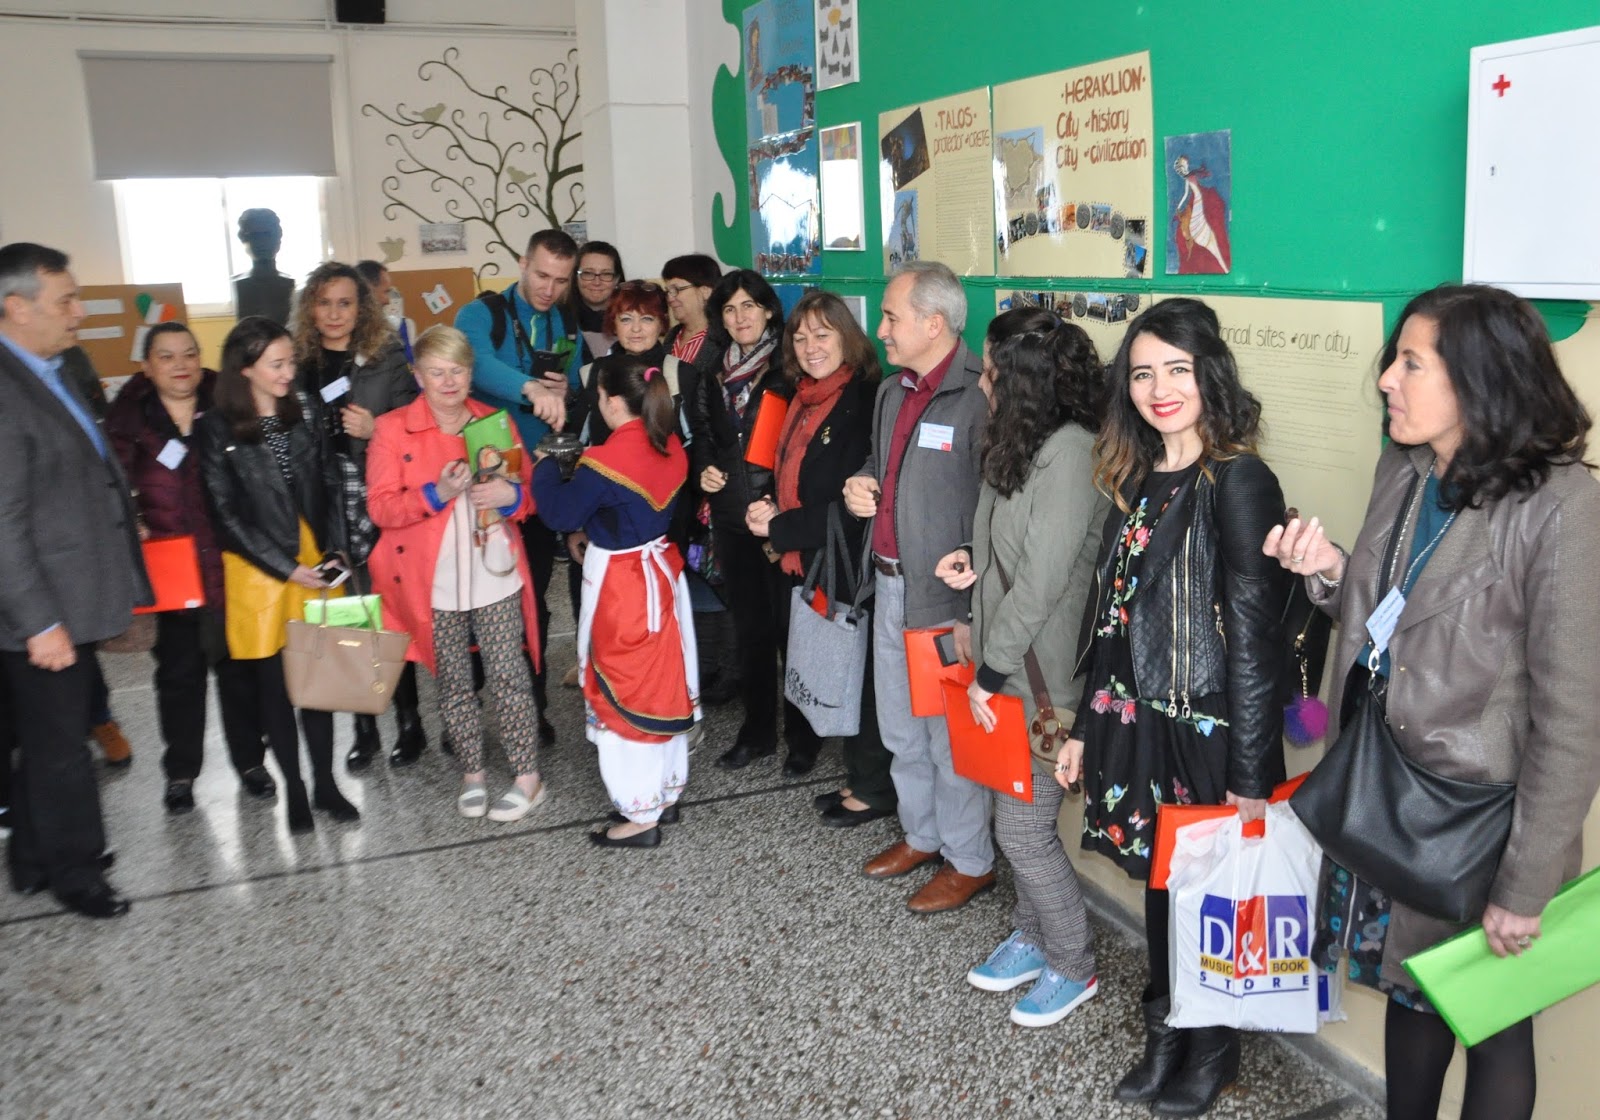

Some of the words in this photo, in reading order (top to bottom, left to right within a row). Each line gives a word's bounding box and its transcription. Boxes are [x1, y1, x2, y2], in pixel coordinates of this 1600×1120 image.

[937, 106, 973, 131] TALOS
[1056, 110, 1079, 141] City
[1091, 107, 1129, 133] history
[933, 132, 964, 158] protector
[1056, 144, 1079, 171] City
[1090, 136, 1147, 164] civilization
[1256, 325, 1287, 348] sites
[1298, 332, 1321, 350] our
[1200, 957, 1233, 975] MUSIC
[1272, 960, 1305, 973] BOOK
